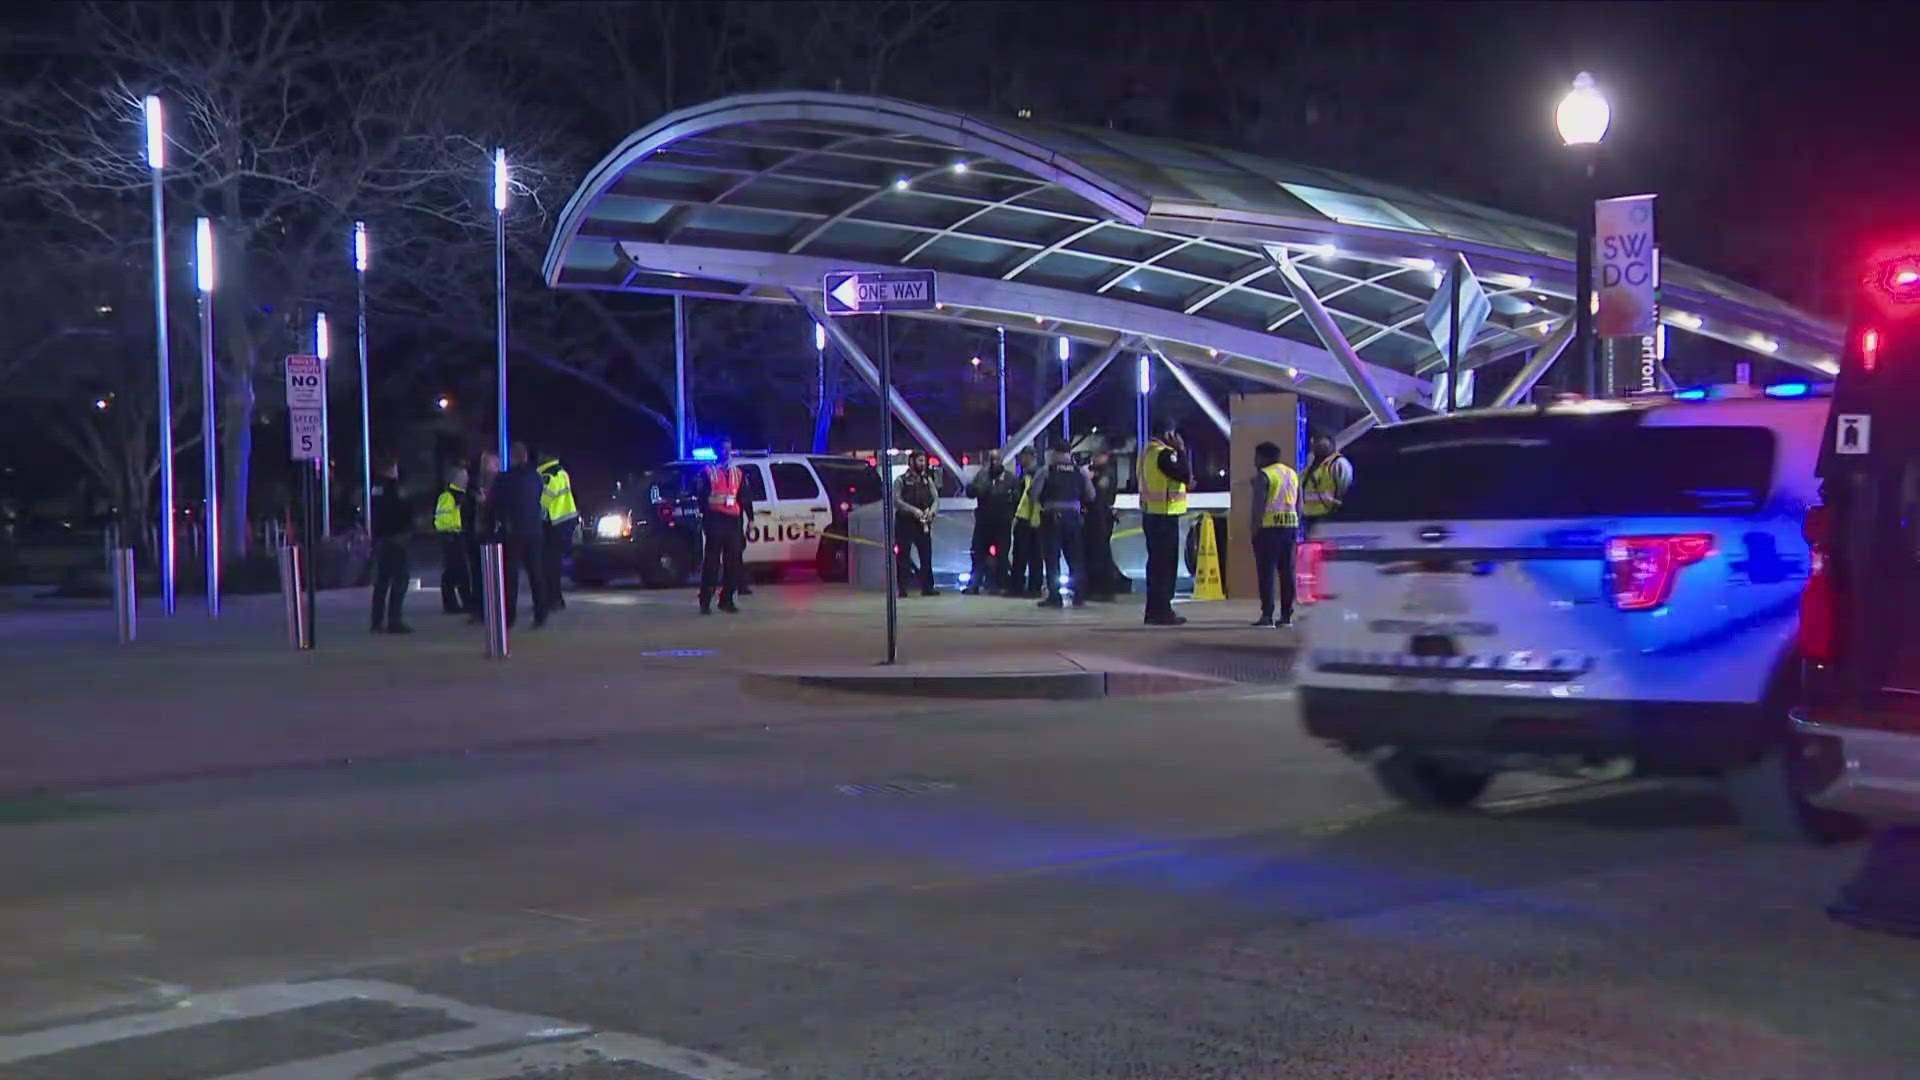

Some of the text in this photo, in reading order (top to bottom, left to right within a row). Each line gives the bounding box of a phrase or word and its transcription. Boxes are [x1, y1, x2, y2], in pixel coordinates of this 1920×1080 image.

[1603, 233, 1647, 260] SW
[1603, 263, 1648, 288] DC
[858, 282, 922, 300] ONE WAY
[291, 375, 318, 387] NO
[301, 435, 313, 452] 5
[746, 522, 816, 543] OLICE
